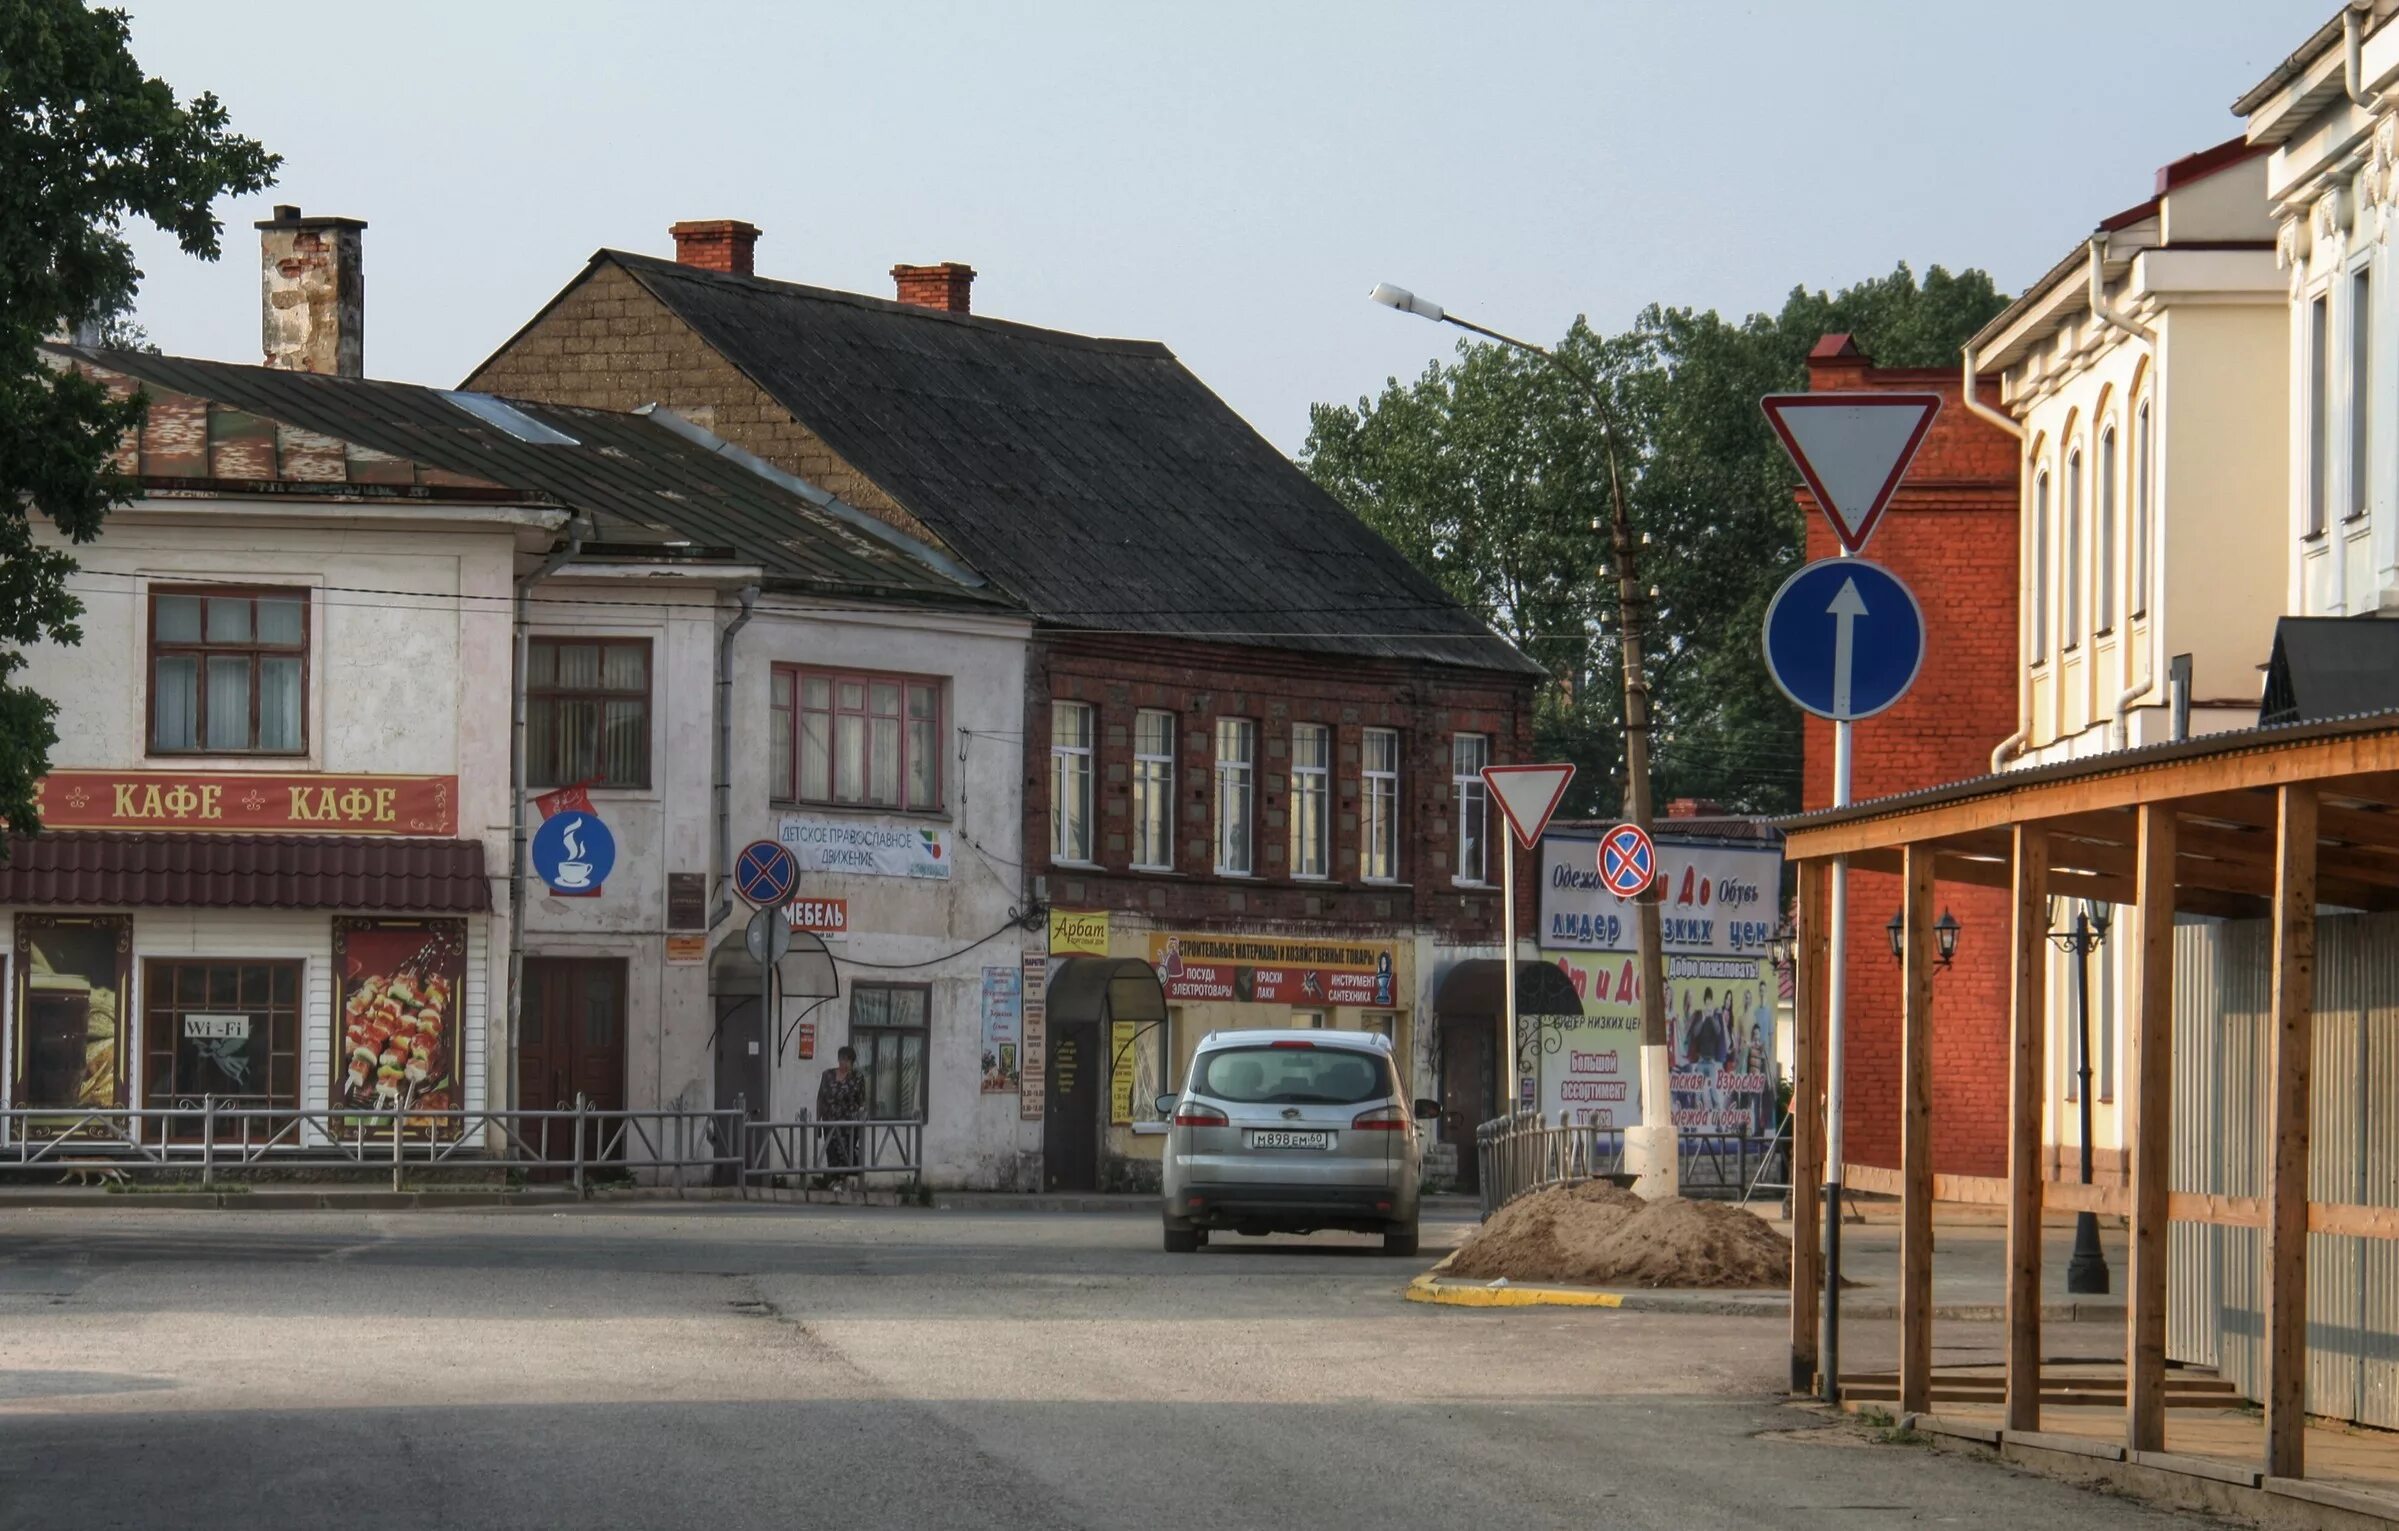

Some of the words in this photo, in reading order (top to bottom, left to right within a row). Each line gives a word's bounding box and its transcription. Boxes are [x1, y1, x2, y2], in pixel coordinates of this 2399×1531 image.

[112, 783, 222, 819] КАФЕ
[287, 786, 397, 822] КАФЕ
[782, 826, 827, 843] ДЕТСКОЕ
[829, 829, 912, 848] ПРАВОСЛАВНОЕ
[821, 849, 873, 867] ДВИЖЕНИЕ
[1678, 865, 1711, 906] До
[1719, 878, 1759, 908] Обувь
[781, 902, 843, 927] МЕБЕЛЬ
[1053, 917, 1104, 943] Арбат
[1553, 913, 1620, 945] лидер
[1730, 921, 1767, 949] цен
[1179, 940, 1234, 959] СТРОИТЕЛЬНЫЕ
[1236, 943, 1279, 960] МАТЕРИАЛЫ
[1280, 945, 1285, 961] И
[1285, 944, 1344, 963] ХОЗЯЙСТВЕННЫЕ
[1346, 948, 1375, 965] ТОВАРЫ
[1186, 967, 1215, 982] ПОСУДА
[1257, 971, 1282, 983] КРАСКИ
[1331, 974, 1376, 987] ИНСТРУМЕНТ
[1669, 957, 1698, 979] Добро
[1698, 959, 1759, 979] пожаловать!
[1172, 983, 1232, 997] ЭЛЕКТРОТОВАРЫ
[1257, 986, 1275, 999] ЛАКИ
[1328, 990, 1371, 1002] САНТЕХНИКА
[1587, 1016, 1624, 1029] НИЗКИХ
[1571, 1050, 1617, 1073] Большой
[1561, 1081, 1626, 1101] ассортимент
[1716, 1069, 1766, 1091] Взрослая
[1310, 1134, 1322, 1143] 60
